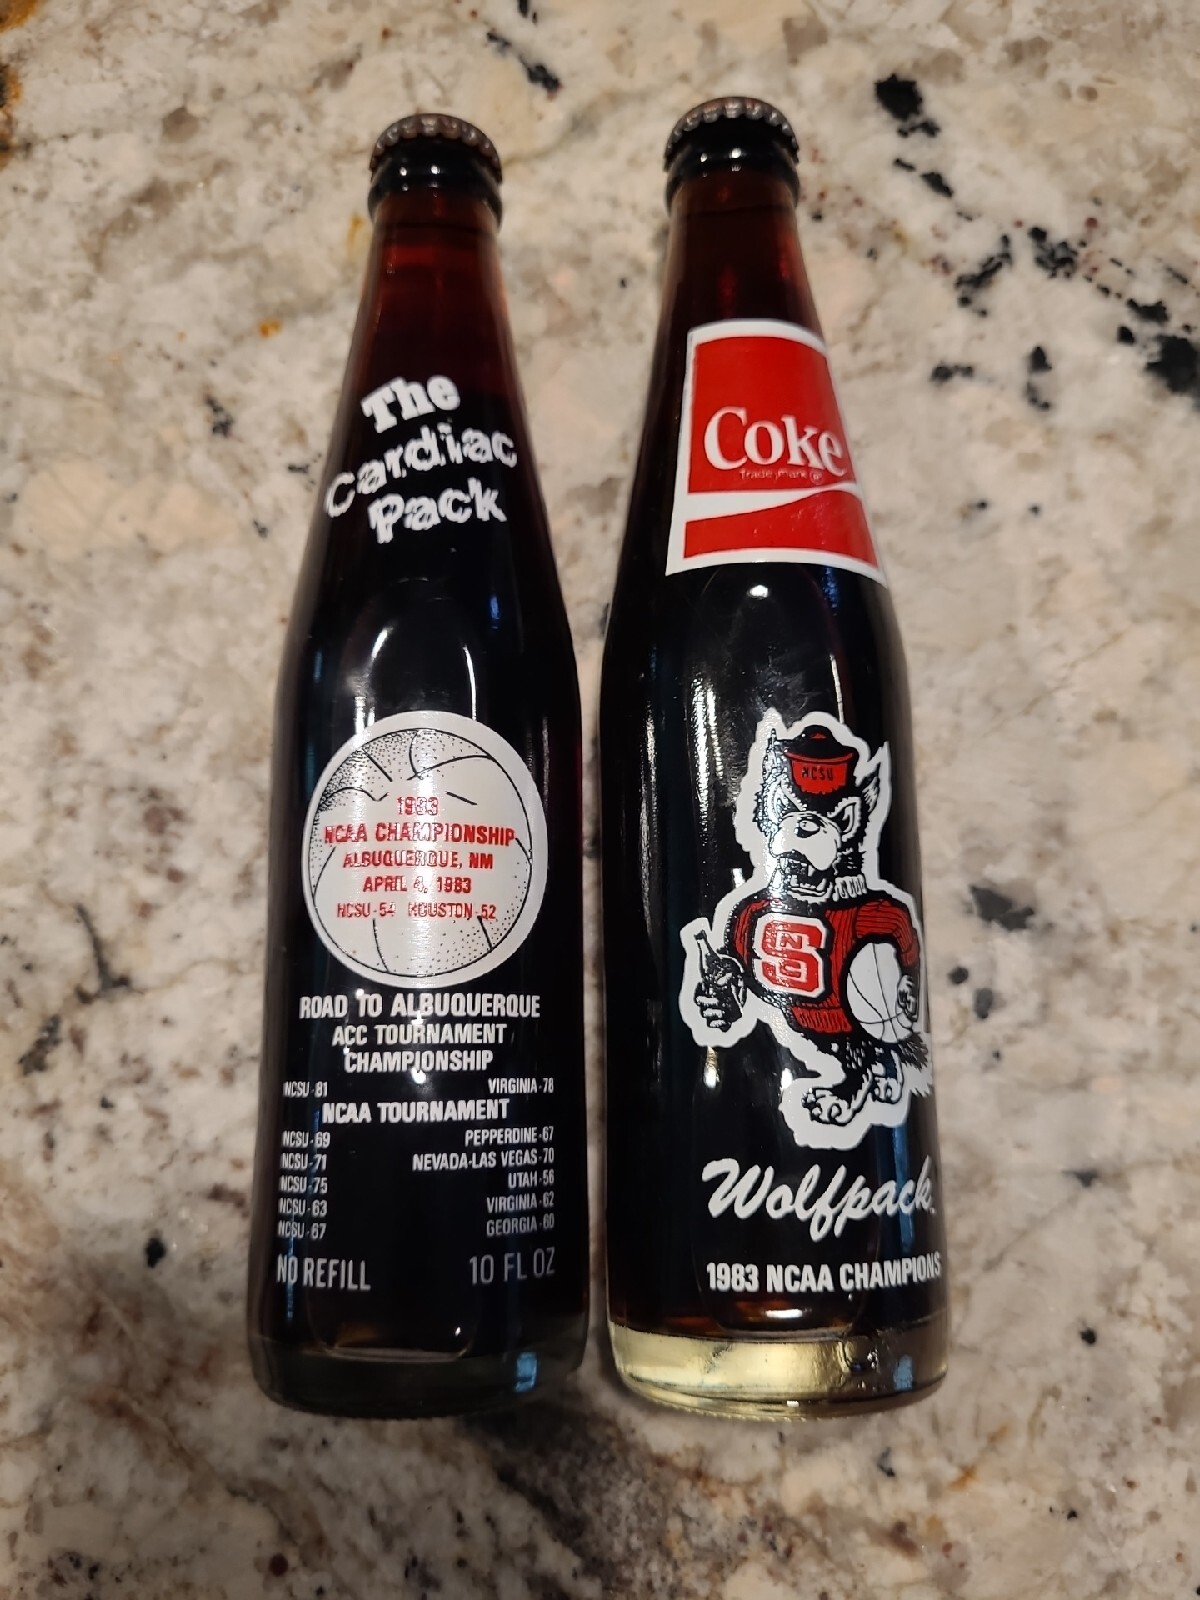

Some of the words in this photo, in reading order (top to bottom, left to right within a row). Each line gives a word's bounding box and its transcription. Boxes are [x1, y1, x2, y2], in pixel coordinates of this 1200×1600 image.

[361, 375, 460, 433] The
[704, 406, 847, 477] Coke
[325, 422, 518, 518] Cardiac
[801, 766, 834, 781] NCSU
[324, 823, 368, 844] NCAA
[375, 822, 515, 846] CHAMPIONSHIP
[342, 850, 463, 869] ALBUQUERQUE,
[469, 852, 493, 870] NM
[362, 875, 408, 893] APRIL
[436, 876, 472, 894] 1983
[299, 995, 348, 1019] ROAD
[358, 994, 382, 1017] TO
[390, 993, 541, 1018] ALBUQUERQUE
[332, 1025, 368, 1046] ACC
[373, 1023, 508, 1045] TOURNAMENT
[344, 1050, 494, 1073] CHAMPIONSHIP
[322, 1102, 372, 1124] NCAA
[377, 1098, 511, 1123] TOURNAMENT
[412, 1152, 497, 1171] NEVADA-LAS
[701, 1155, 933, 1242] Wolfpack
[277, 1254, 298, 1284] NO
[303, 1258, 371, 1290] REFILL
[469, 1254, 494, 1285] 10
[504, 1252, 527, 1282] FL
[533, 1247, 555, 1277] OZ
[706, 1262, 759, 1292] 1983
[767, 1264, 834, 1292] NCAA
[840, 1251, 942, 1291] CHAMPIONS
